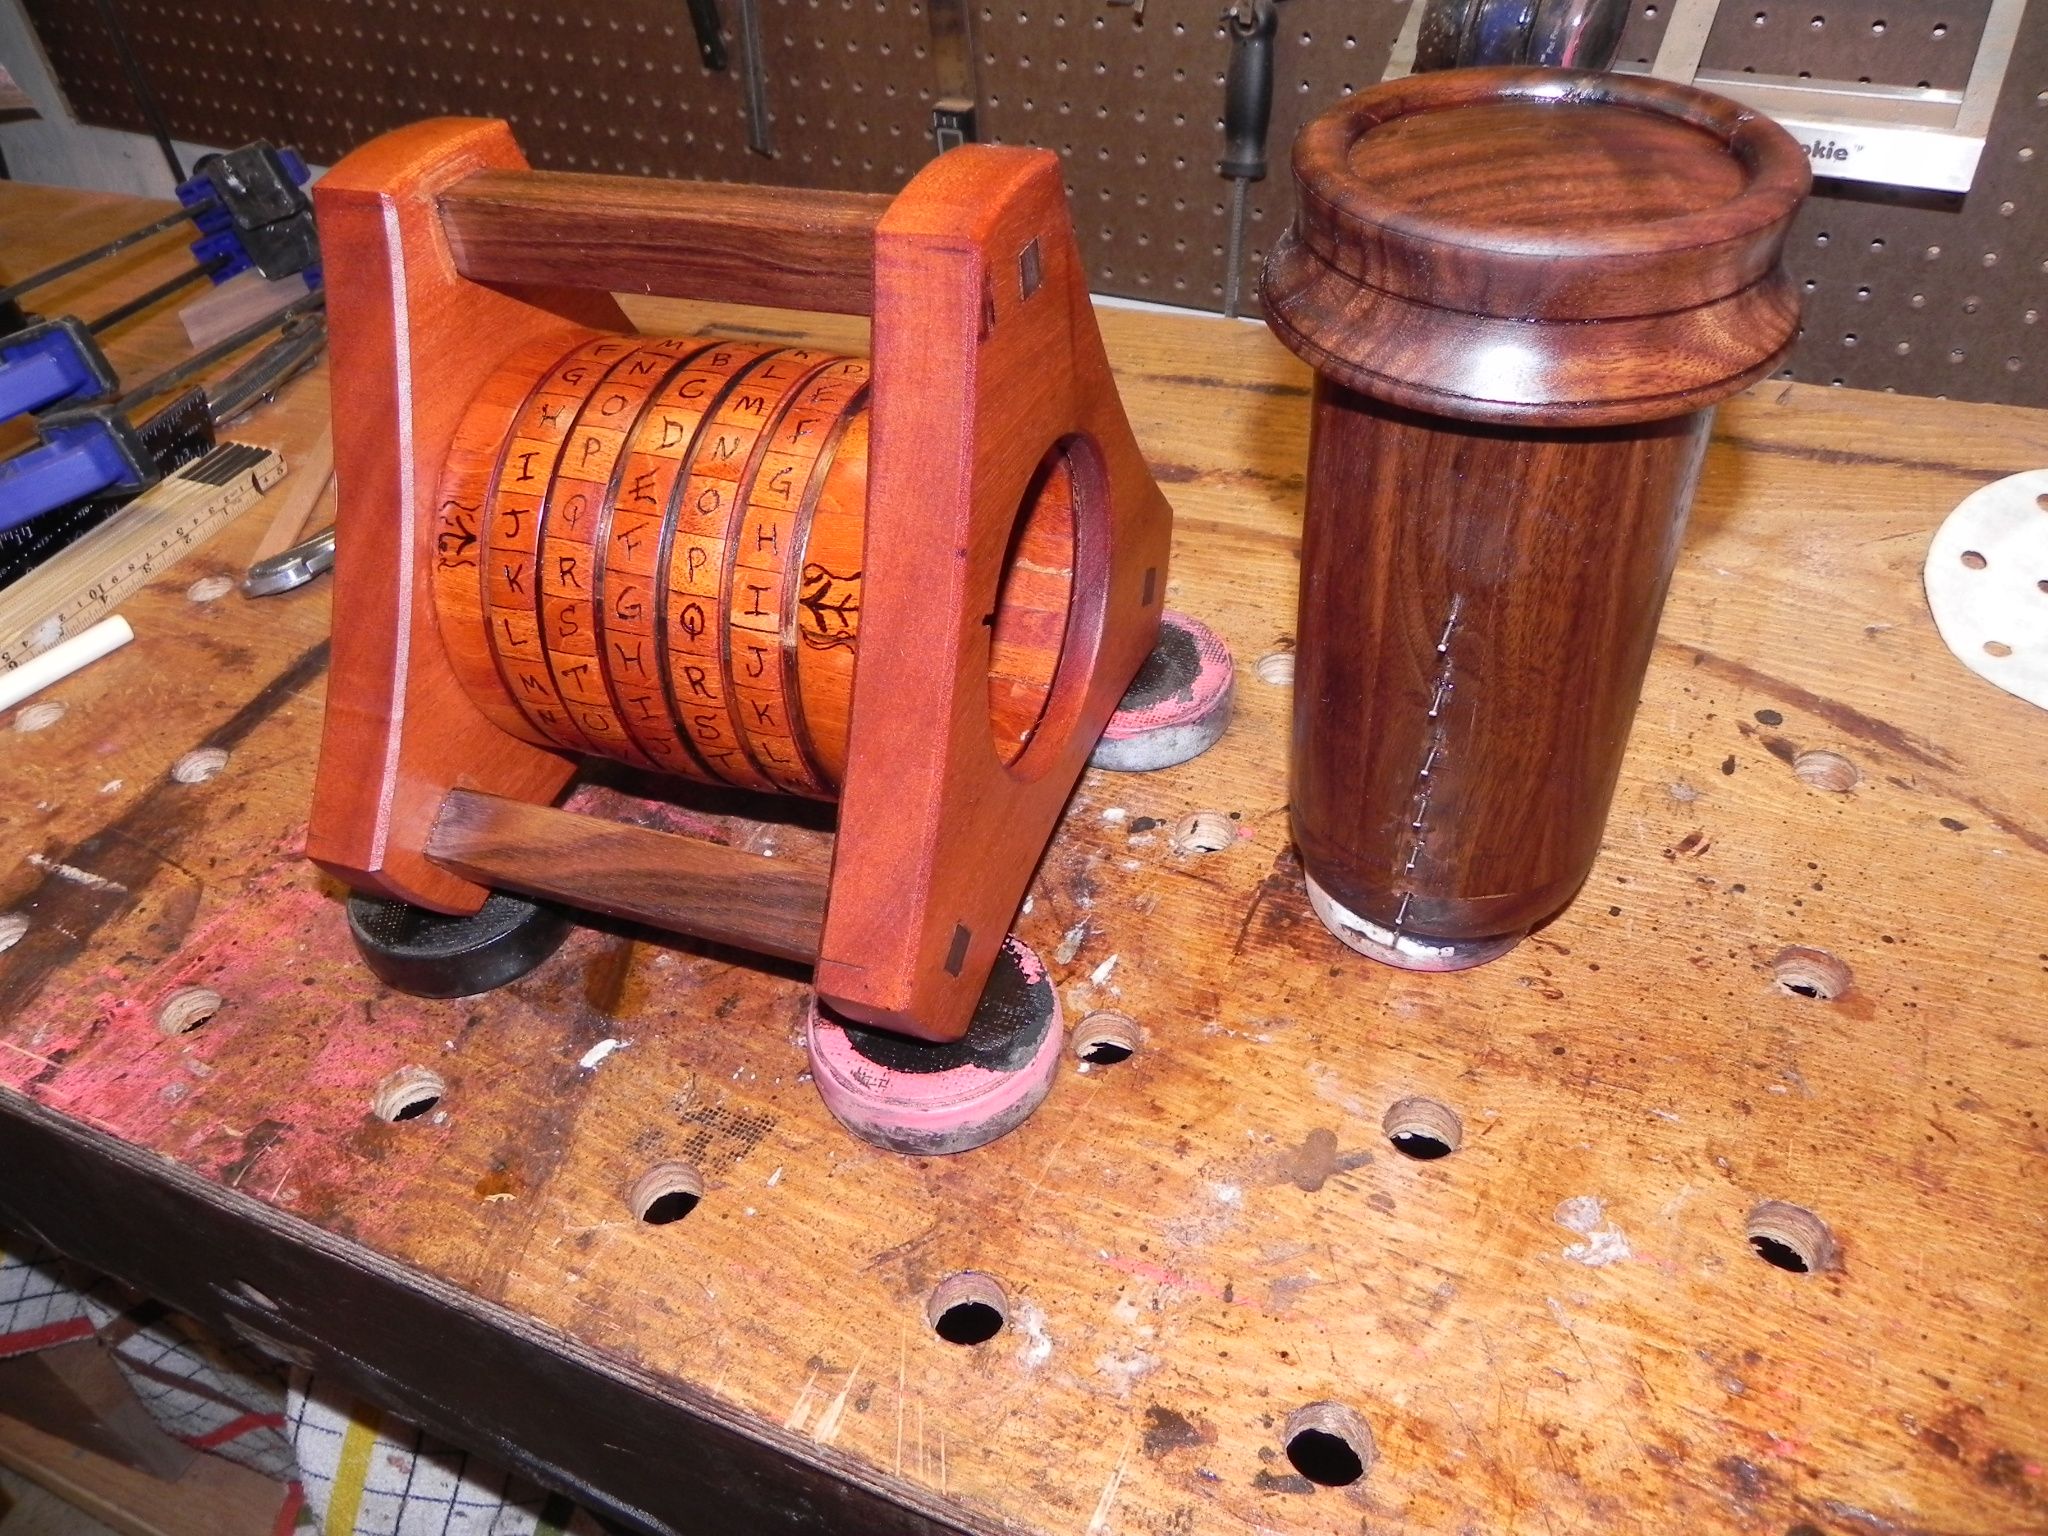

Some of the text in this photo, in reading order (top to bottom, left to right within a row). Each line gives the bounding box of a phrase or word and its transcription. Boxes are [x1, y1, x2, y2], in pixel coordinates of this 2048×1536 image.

[594, 344, 622, 356] F
[656, 339, 684, 351] M
[628, 360, 657, 376] N
[711, 353, 732, 367] B
[760, 365, 786, 380] L
[562, 367, 588, 386] G
[678, 378, 707, 398] C
[601, 394, 628, 416] O
[732, 395, 769, 416] M
[655, 415, 684, 451] D
[581, 437, 601, 468] P
[711, 436, 740, 461] N
[515, 451, 541, 482] I
[628, 466, 661, 505] E
[768, 466, 793, 501] G
[562, 493, 587, 531] Q
[697, 488, 720, 516] O
[501, 508, 530, 538] J
[617, 522, 650, 561] F
[757, 522, 778, 556] H
[504, 563, 525, 594] K
[559, 556, 581, 588] R
[688, 547, 707, 583] P
[615, 585, 642, 621] G
[744, 584, 771, 616] I
[504, 618, 528, 646] L
[559, 604, 578, 637] S
[680, 602, 705, 642] Q
[614, 641, 647, 679] H
[746, 645, 769, 678] J
[519, 673, 550, 697] M
[561, 664, 588, 693] T
[683, 666, 717, 699] R
[628, 695, 660, 720] I
[751, 699, 776, 726] K
[694, 713, 721, 740] S
[707, 752, 734, 769] T
[762, 742, 791, 763] L
